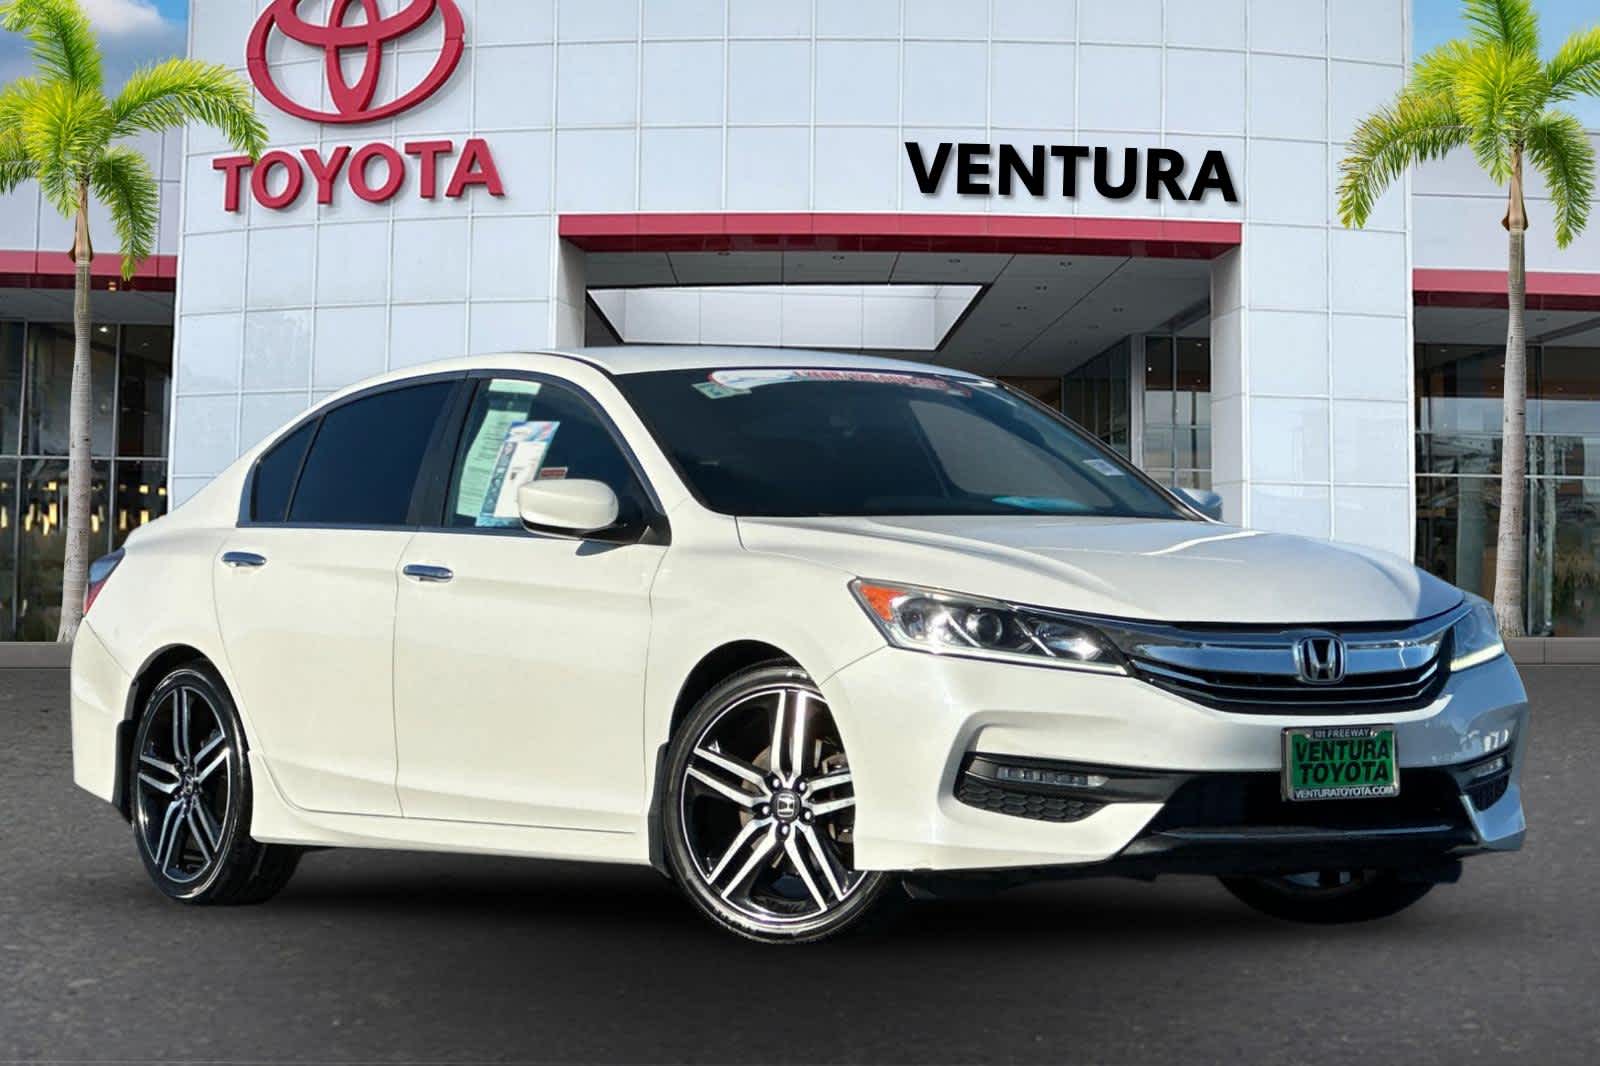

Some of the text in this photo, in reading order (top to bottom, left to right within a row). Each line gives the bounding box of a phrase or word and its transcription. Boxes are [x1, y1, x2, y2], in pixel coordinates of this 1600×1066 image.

[212, 139, 505, 212] TOYOTA
[904, 142, 1238, 203] VENTURA
[1328, 729, 1370, 738] FREEWAY
[1296, 739, 1390, 761] VENTURA
[1299, 761, 1389, 785] TOYOTA
[1295, 785, 1394, 799] VENTURATOYOTA.COM
